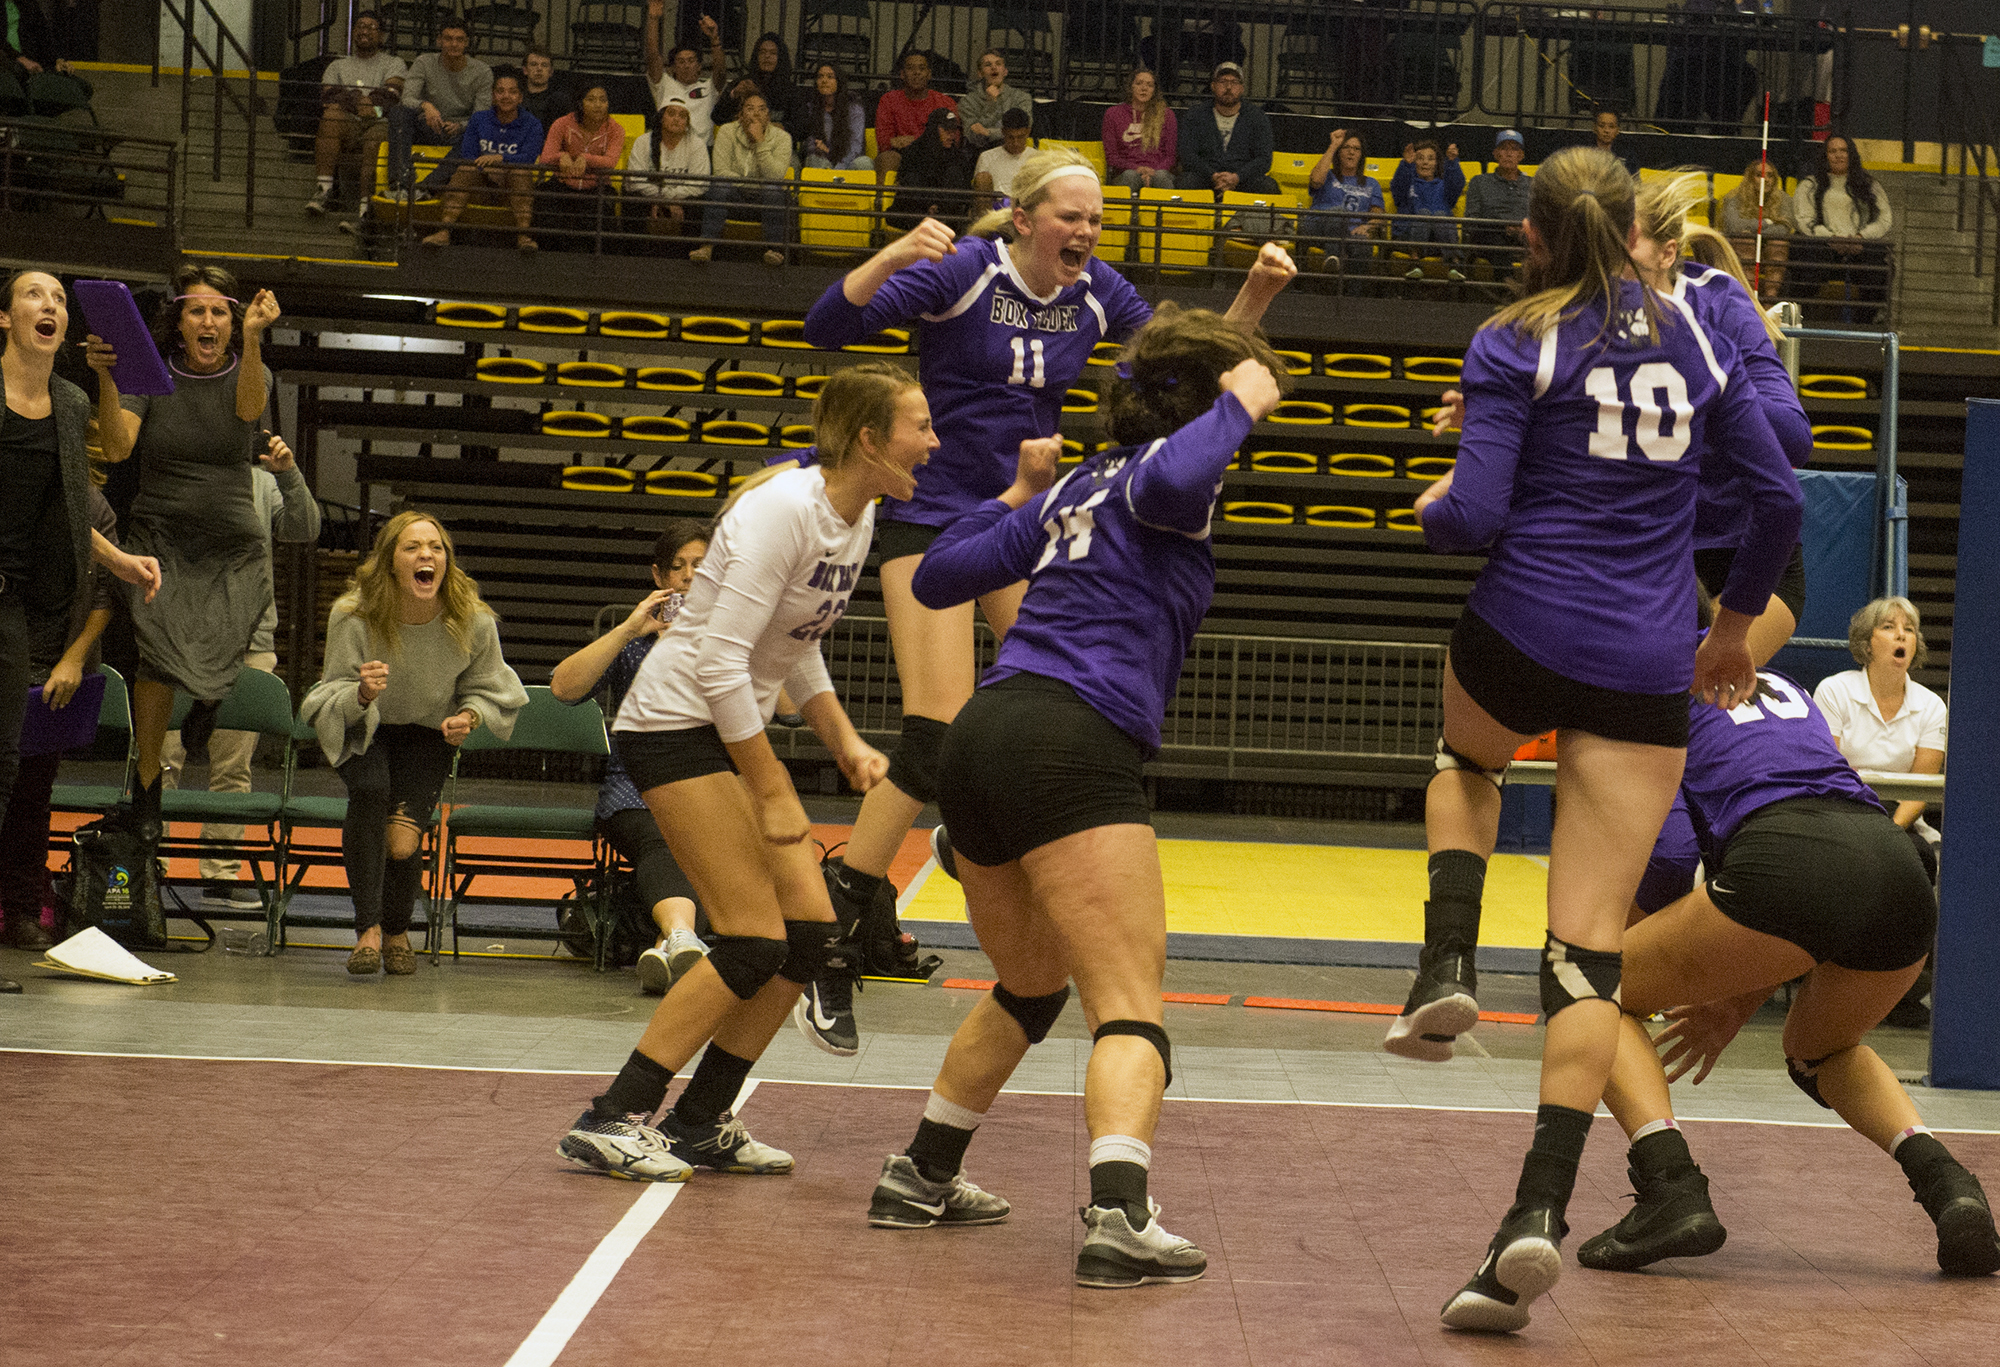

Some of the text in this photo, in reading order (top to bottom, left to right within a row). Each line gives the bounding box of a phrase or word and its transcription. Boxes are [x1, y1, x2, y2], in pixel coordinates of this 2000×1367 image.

[479, 138, 519, 155] SLCC
[989, 294, 1029, 330] BOX
[1007, 336, 1047, 389] 11
[1584, 361, 1695, 462] 10
[1031, 487, 1110, 575] 14
